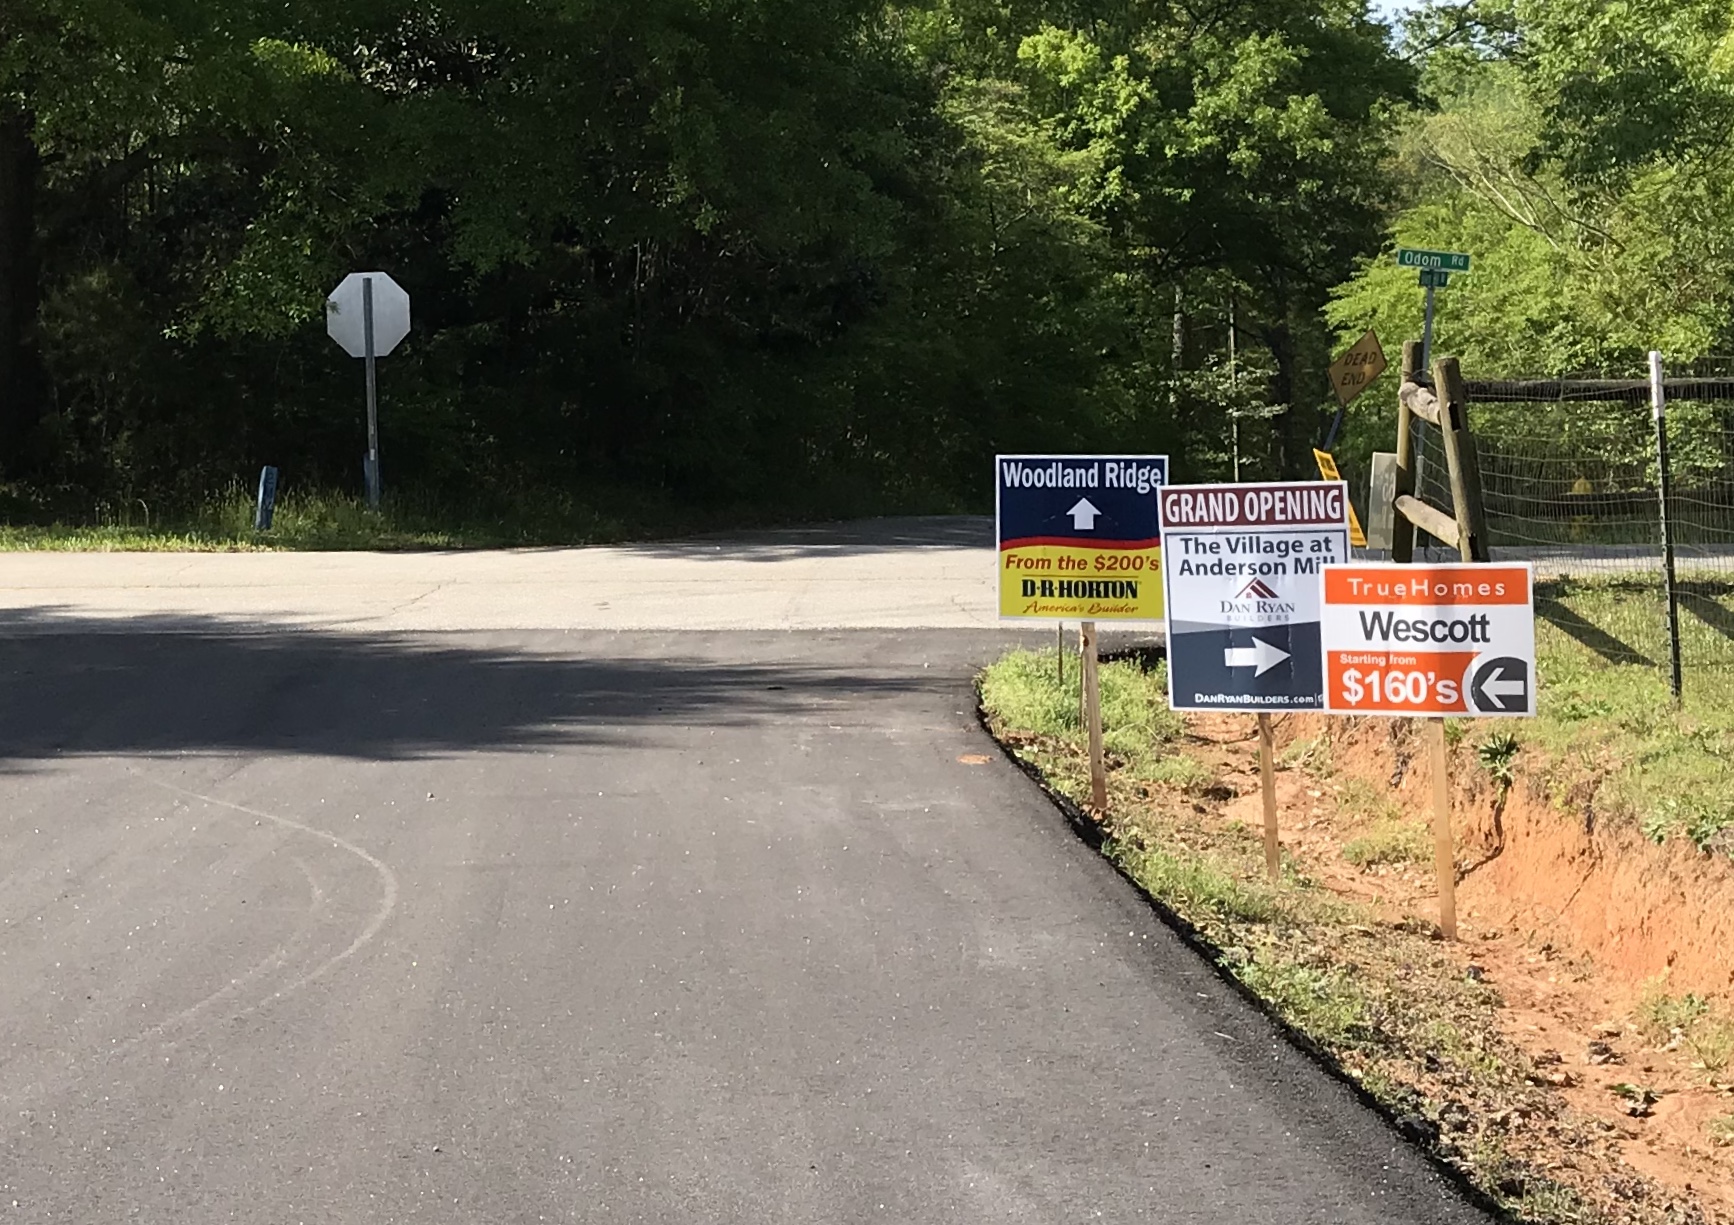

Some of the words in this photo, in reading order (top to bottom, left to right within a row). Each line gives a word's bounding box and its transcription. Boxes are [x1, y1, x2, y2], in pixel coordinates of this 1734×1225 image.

[1404, 251, 1441, 267] Odom
[1451, 255, 1465, 267] Rd
[1344, 351, 1377, 366] DEAD
[1341, 371, 1366, 386] END
[1002, 462, 1099, 488] Woodland
[1105, 462, 1162, 494] Ridge
[1165, 492, 1239, 523] GRAND
[1244, 489, 1342, 522] OPENING
[1180, 537, 1221, 555] The
[1225, 536, 1304, 558] Village
[1309, 536, 1333, 553] at
[1005, 554, 1052, 570] From
[1057, 555, 1088, 571] the
[1093, 554, 1159, 572] $200's
[1179, 557, 1287, 576] Anderson
[1347, 578, 1505, 596] TrueHomes
[1022, 601, 1084, 614] America's
[1088, 602, 1139, 615] Builder
[1226, 614, 1290, 622] BUILDERS
[1359, 611, 1490, 643] Wescott
[1340, 653, 1386, 666] Starting
[1389, 653, 1417, 665] from
[1342, 667, 1459, 706] $160's
